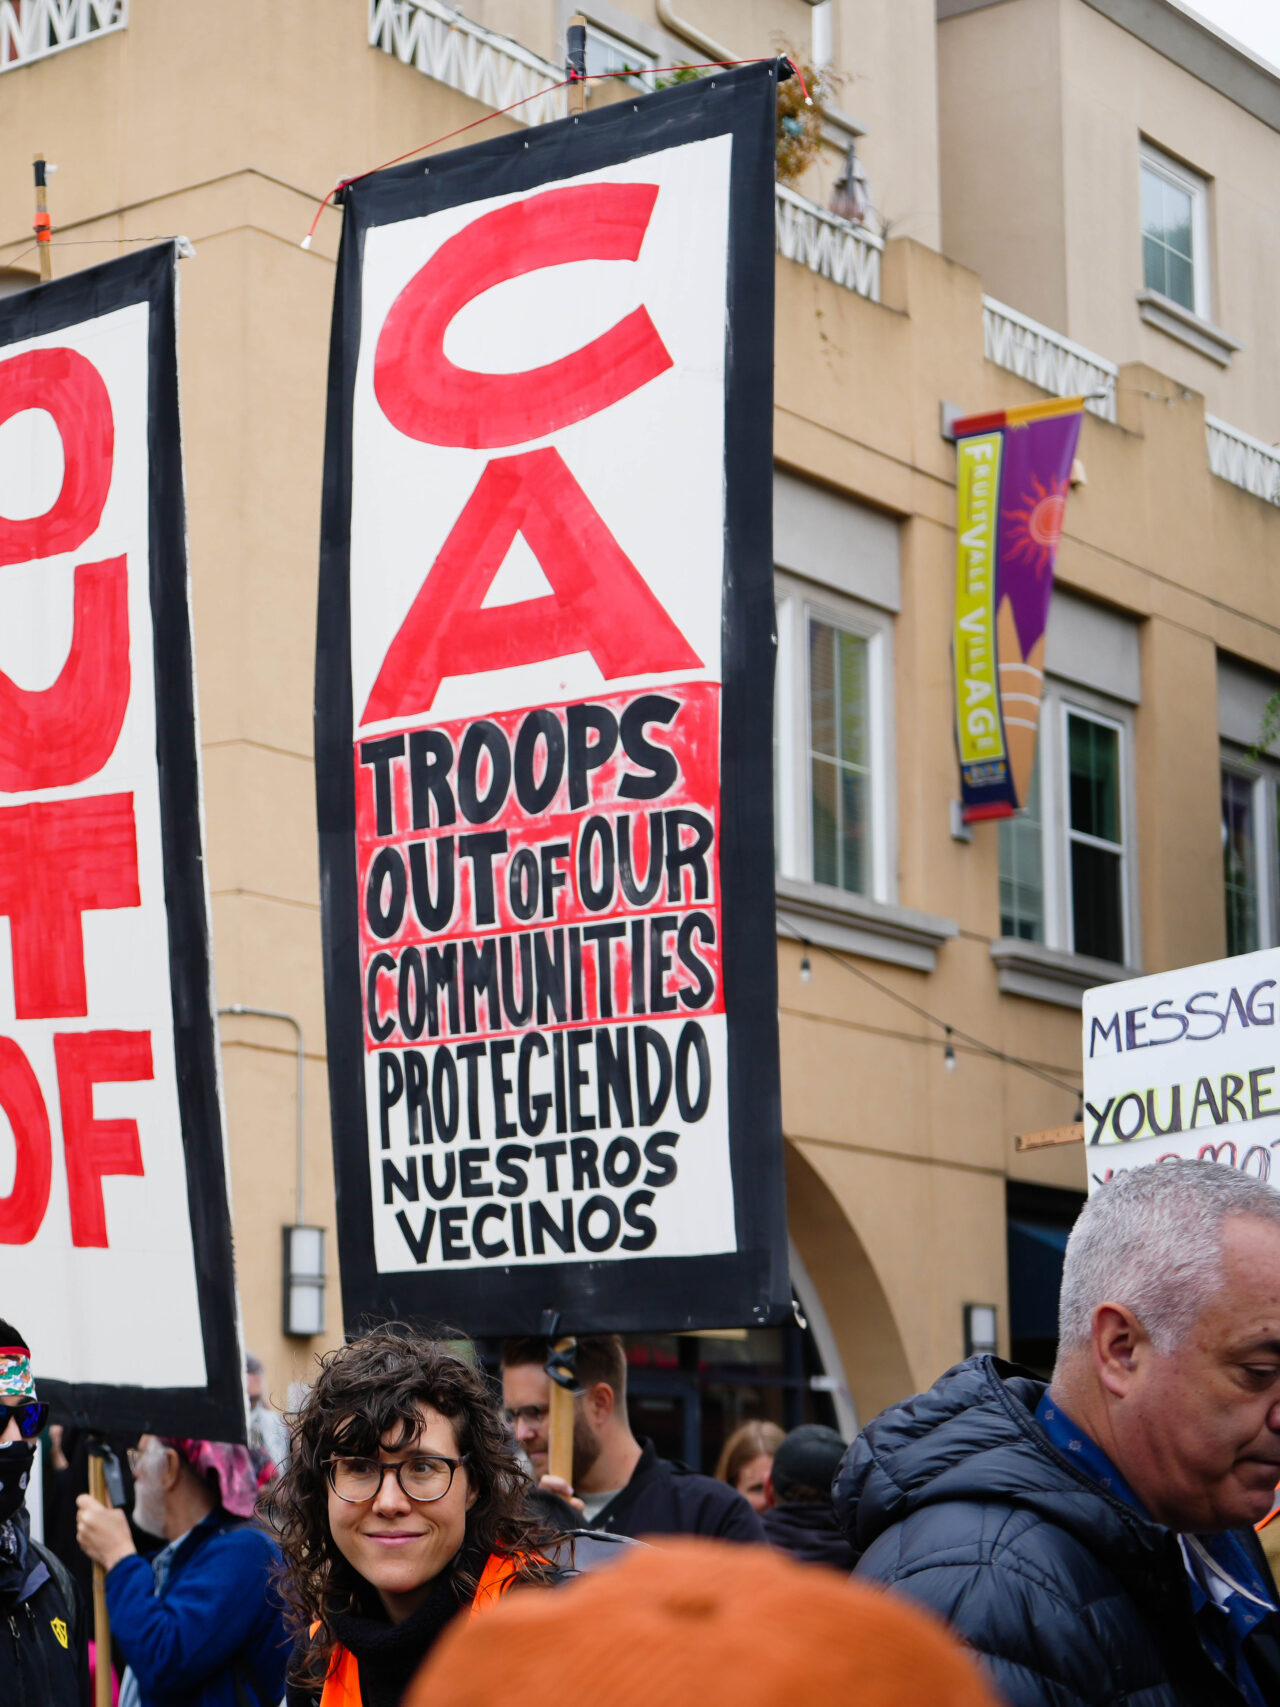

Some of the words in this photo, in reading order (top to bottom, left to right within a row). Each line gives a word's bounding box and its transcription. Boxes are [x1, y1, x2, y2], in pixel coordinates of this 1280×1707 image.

[359, 181, 706, 727] CA
[360, 694, 681, 837] TROOPS
[366, 829, 508, 939] OUT
[509, 842, 570, 920] OF
[578, 808, 715, 911] OUR
[368, 911, 716, 1042] COMMUNITIES
[1089, 979, 1280, 1058] MESSAG
[378, 1020, 712, 1149] PROTEGIENDO
[1085, 1084, 1182, 1146] YOU
[1190, 1065, 1280, 1129] ARE
[381, 1131, 680, 1205] NUESTROS
[395, 1189, 658, 1264] VECINOS
